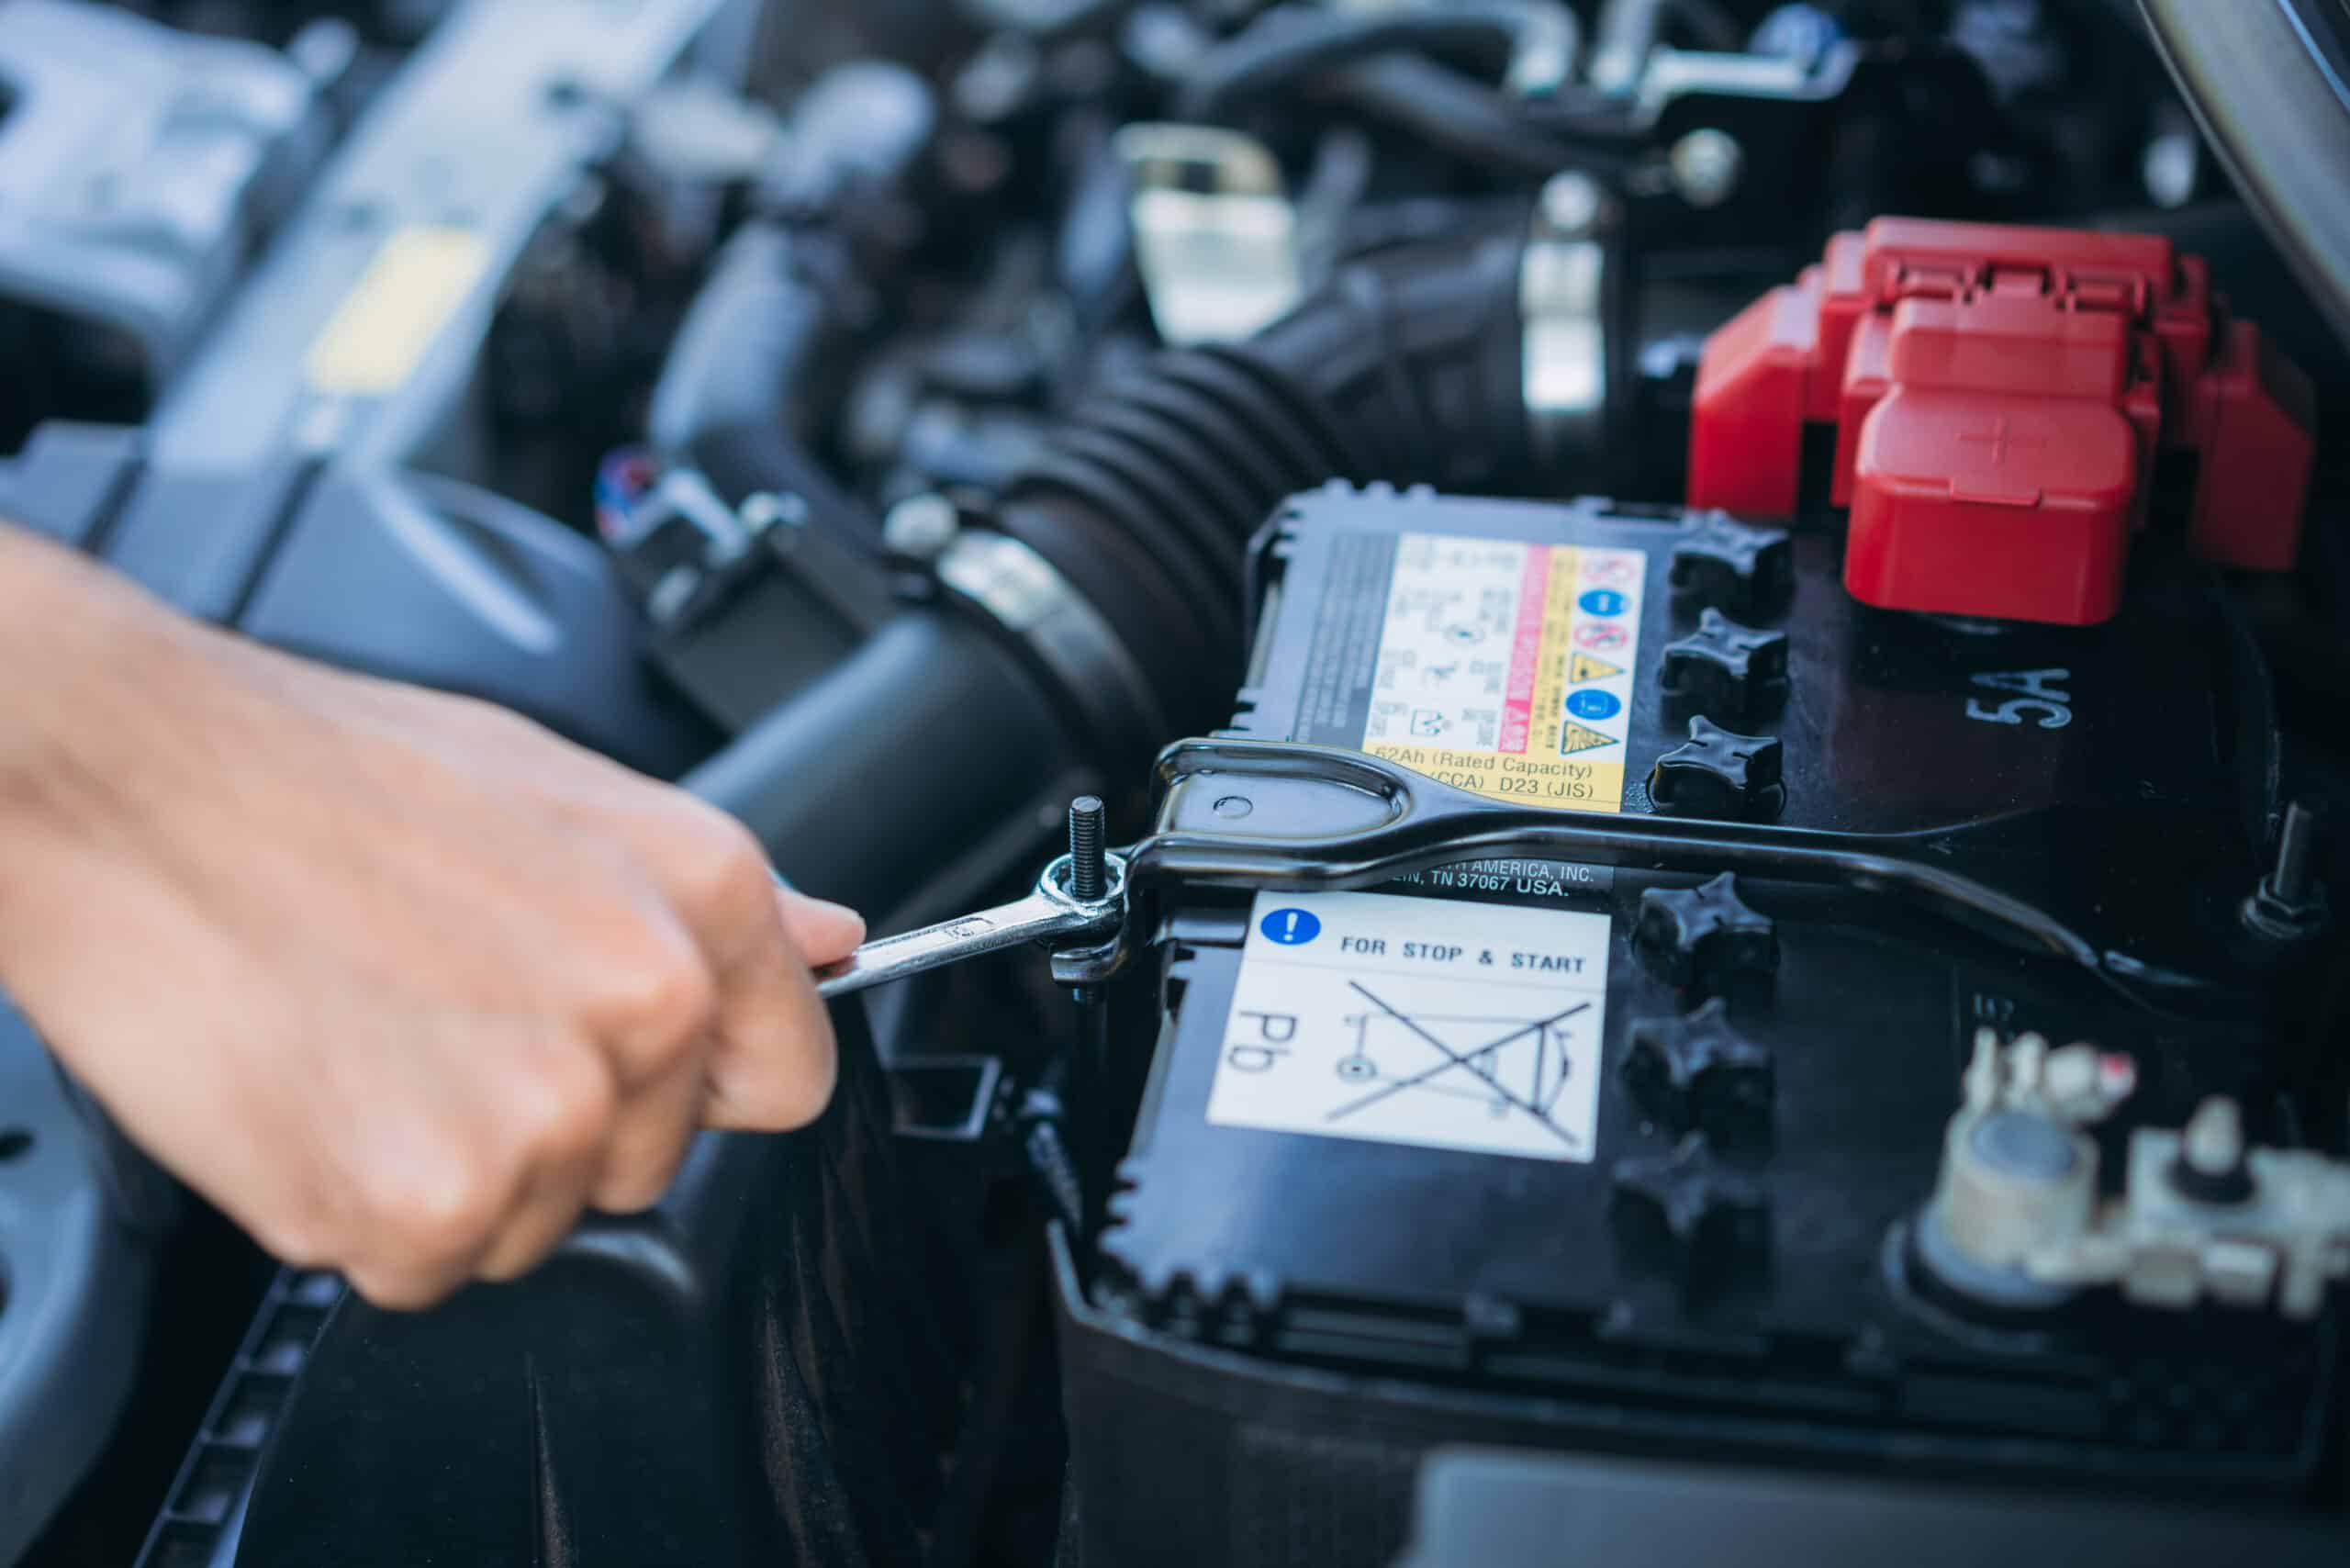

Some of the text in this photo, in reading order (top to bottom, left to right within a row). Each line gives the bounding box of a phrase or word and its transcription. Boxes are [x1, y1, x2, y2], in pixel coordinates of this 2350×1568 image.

[1966, 668, 2072, 728] 5A
[1375, 745, 1594, 780] 62Ah (Rated Capacity)
[1499, 777, 1539, 795] D23
[1547, 781, 1595, 799] (JIS)
[1431, 870, 1453, 887] TN
[1457, 873, 1510, 890] 37067
[1516, 879, 1570, 897] USA.
[1472, 859, 1554, 880] AMERICA,
[1560, 866, 1595, 882] INC.
[1340, 936, 1587, 973] FOR STOP & START
[1227, 1010, 1298, 1073] Pb
